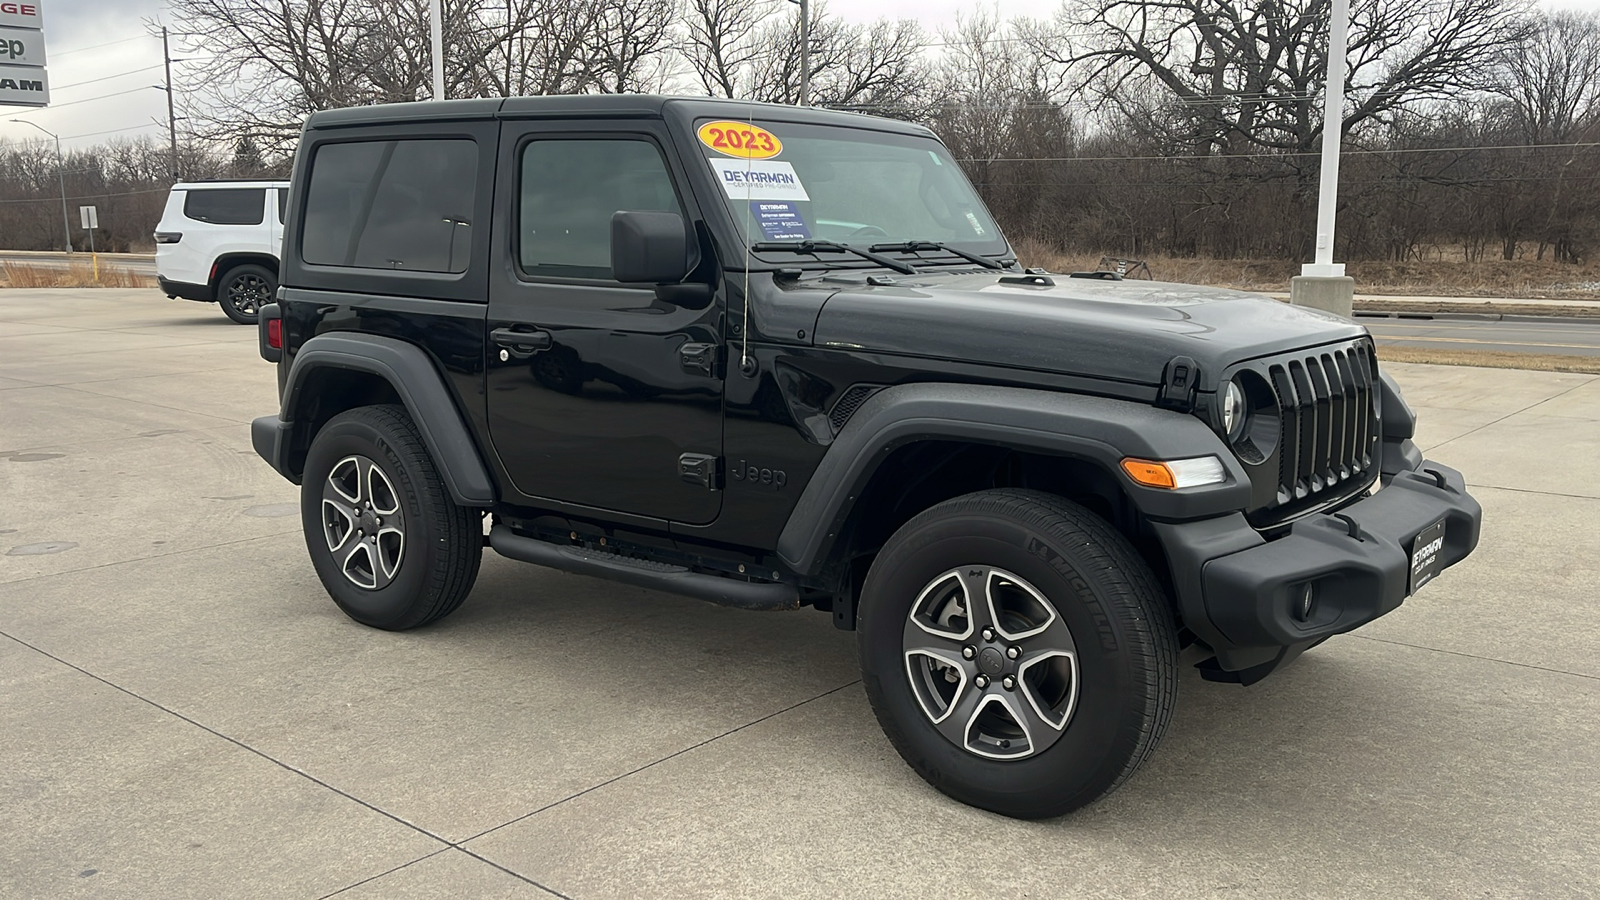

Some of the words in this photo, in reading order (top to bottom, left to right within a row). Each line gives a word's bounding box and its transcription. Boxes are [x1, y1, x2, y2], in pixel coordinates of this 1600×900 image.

[709, 128, 775, 152] 2023
[723, 170, 795, 184] DEYARMAN
[731, 460, 787, 491] Jeep
[1050, 556, 1118, 650] MICHELIN
